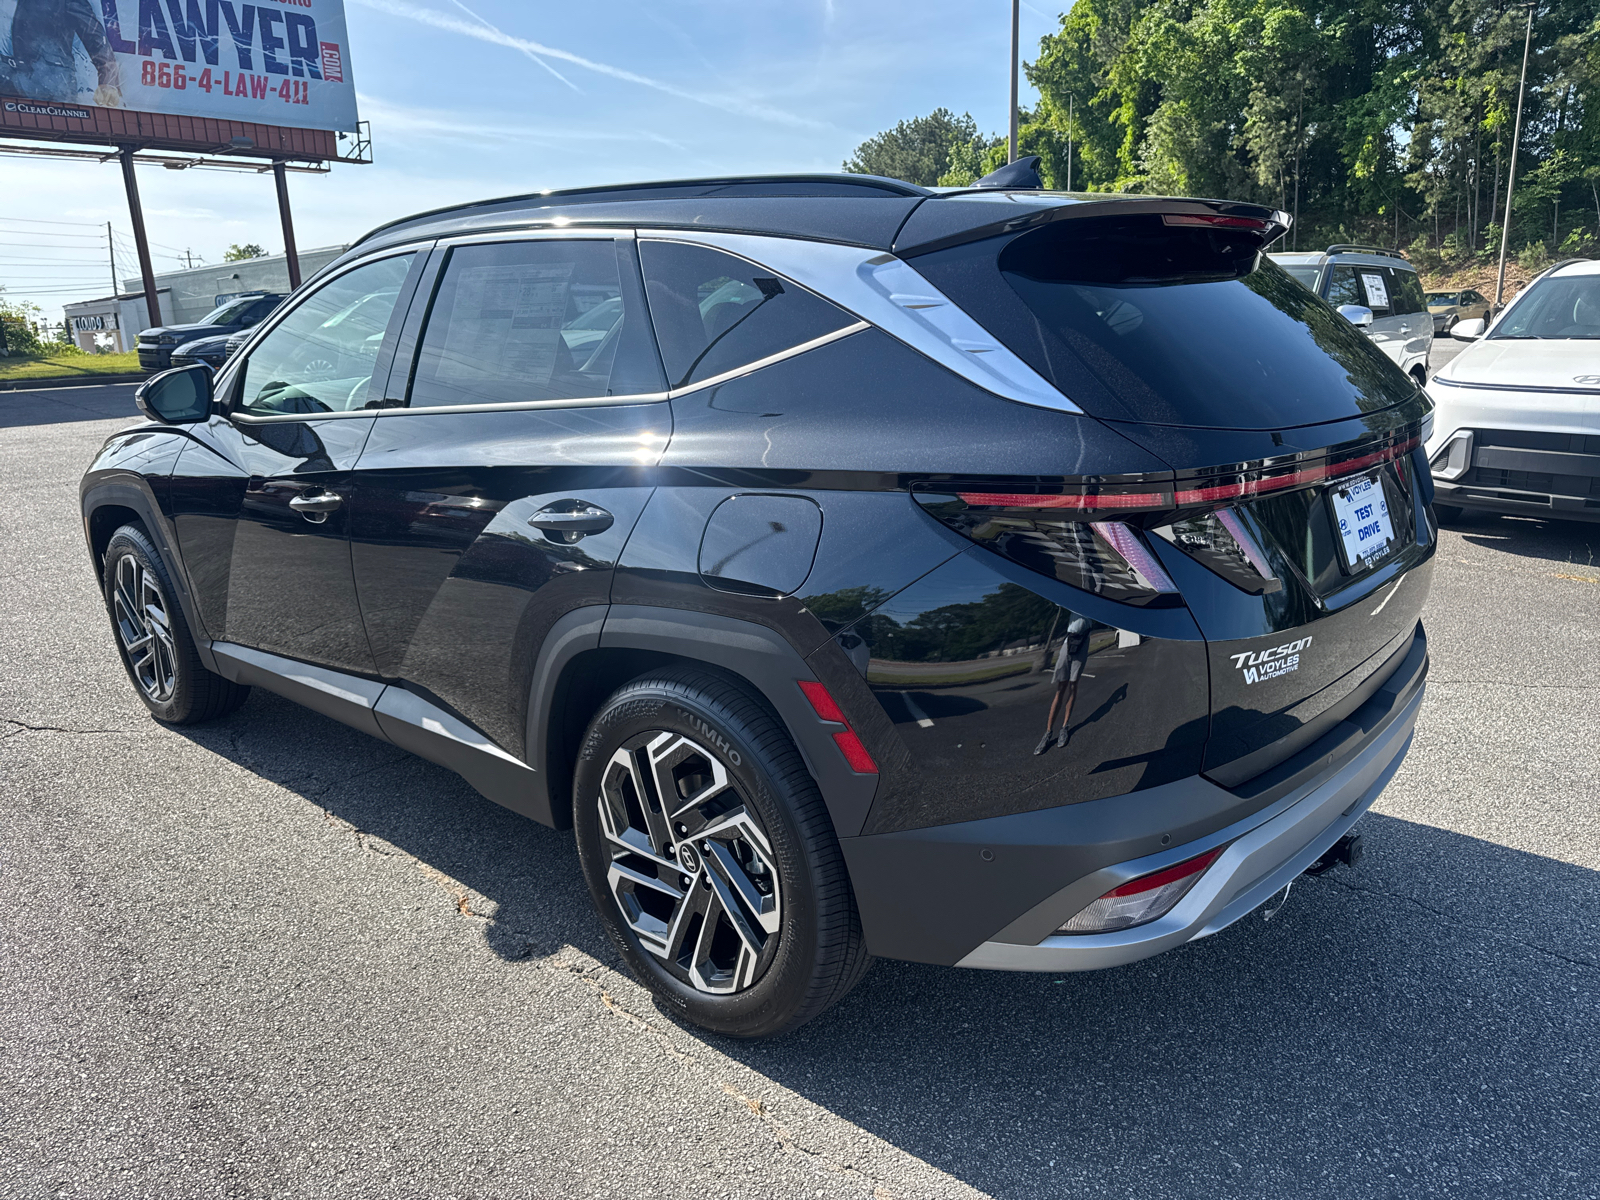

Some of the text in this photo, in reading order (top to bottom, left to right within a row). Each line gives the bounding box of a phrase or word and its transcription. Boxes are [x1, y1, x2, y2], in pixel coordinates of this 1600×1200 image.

[101, 0, 323, 80] LAWYER
[141, 60, 309, 105] 866-4-LAW-411
[1350, 481, 1371, 496] VOYLES
[1354, 503, 1373, 522] TEST
[1358, 520, 1381, 541] DRIVE
[1230, 636, 1313, 669] TUCSON
[1259, 654, 1300, 675] VOYLES
[1259, 664, 1299, 682] AUTOMOTIVE
[677, 708, 742, 766] KUMHO
